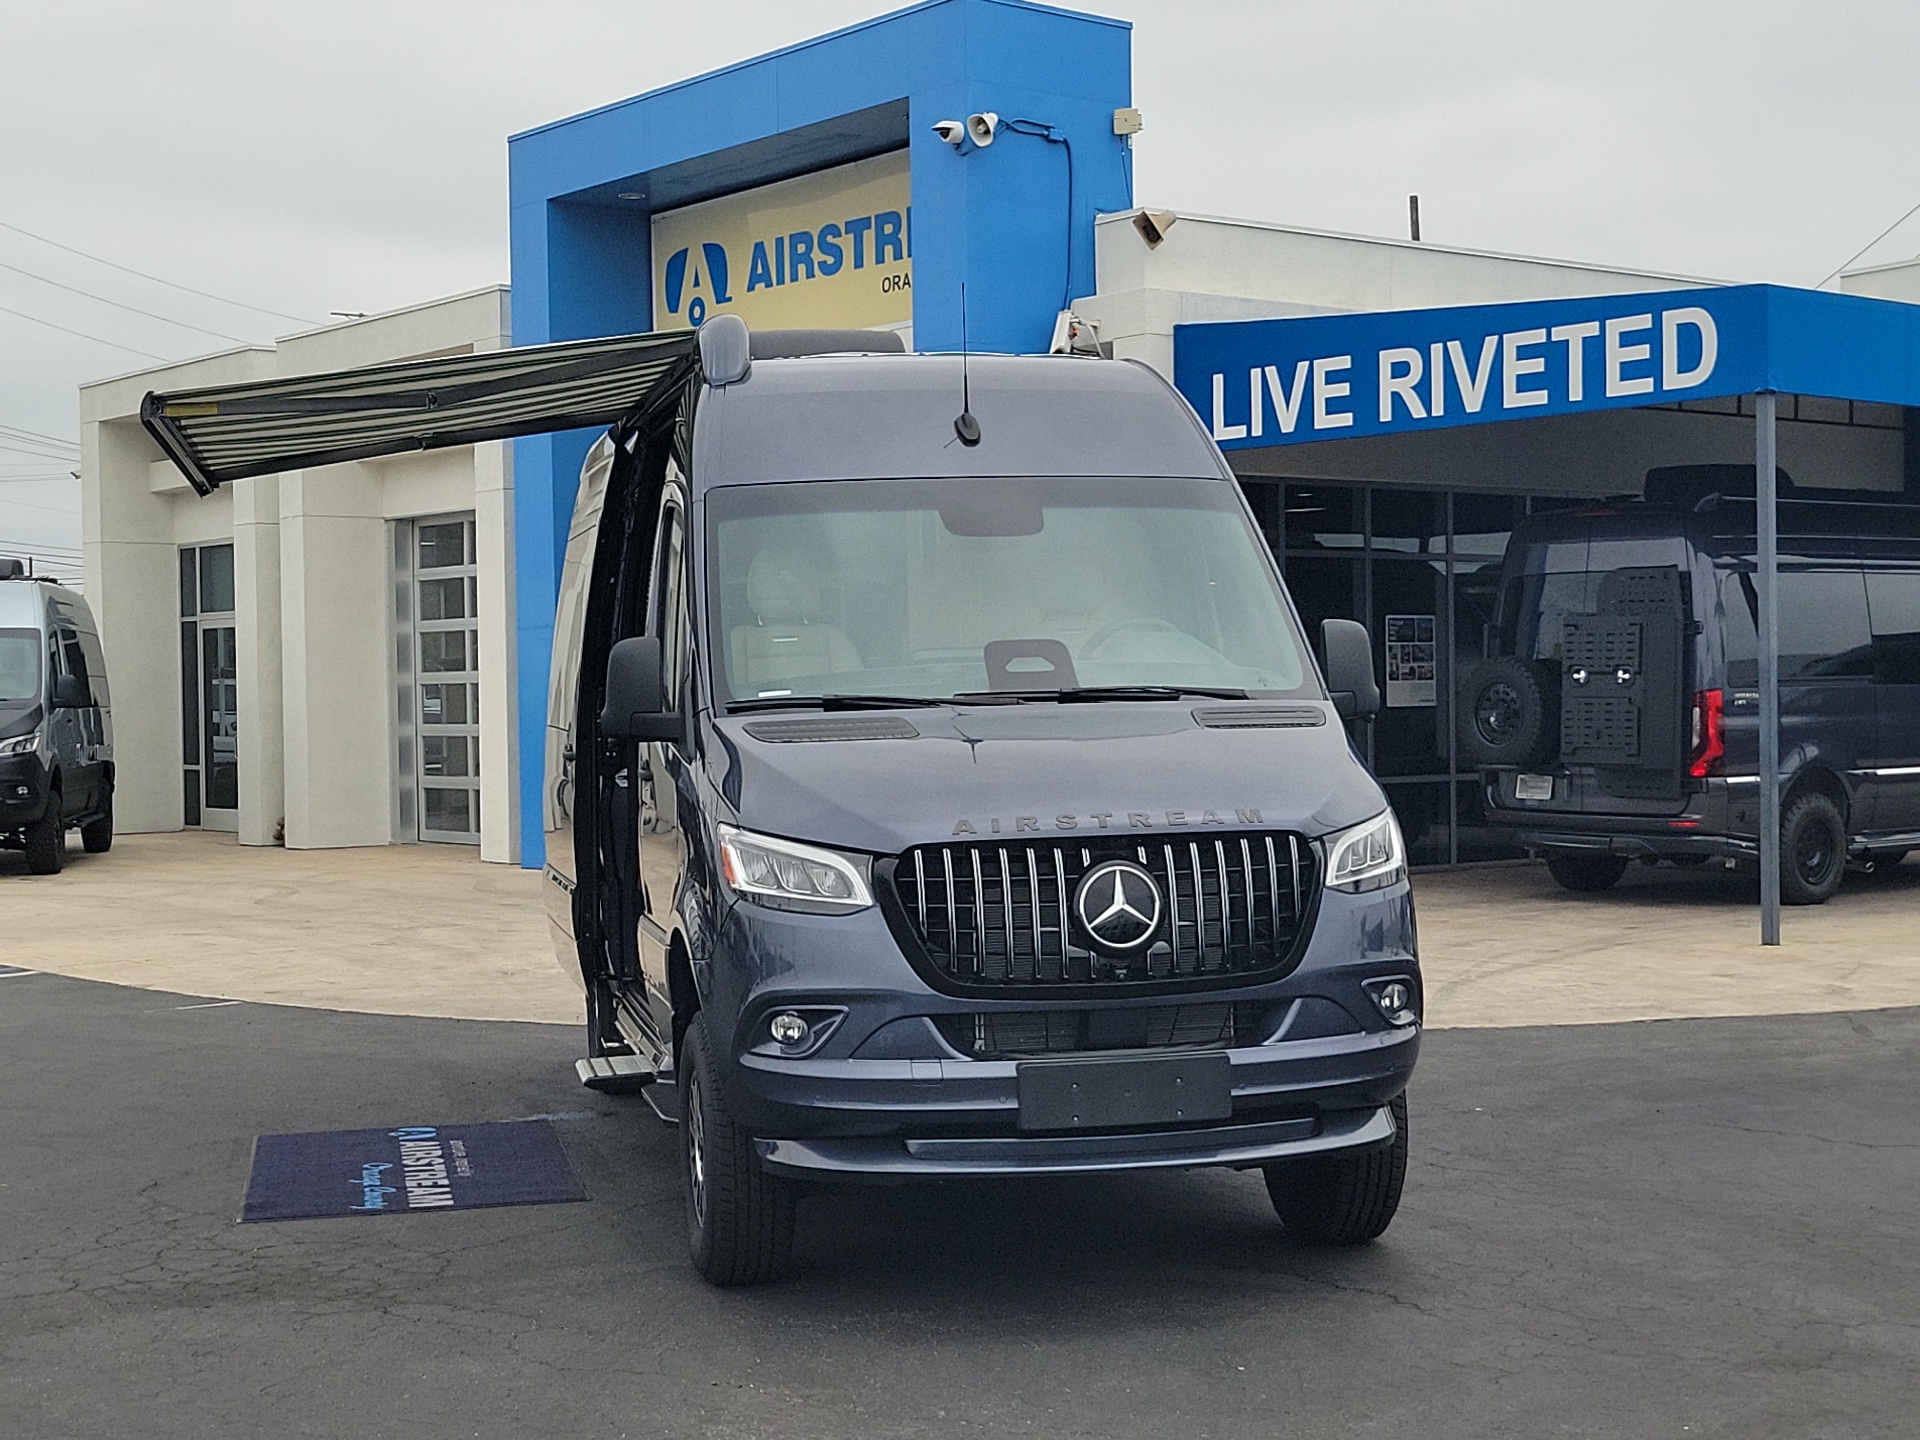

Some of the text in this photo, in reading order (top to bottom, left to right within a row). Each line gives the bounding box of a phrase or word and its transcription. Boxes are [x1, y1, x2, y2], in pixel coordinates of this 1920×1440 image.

[746, 206, 912, 293] AIRSTR
[1212, 306, 1719, 442] LIVE RIVETED
[952, 808, 1264, 836] AIRSTREAM
[399, 1141, 454, 1208] AIRSTREAM
